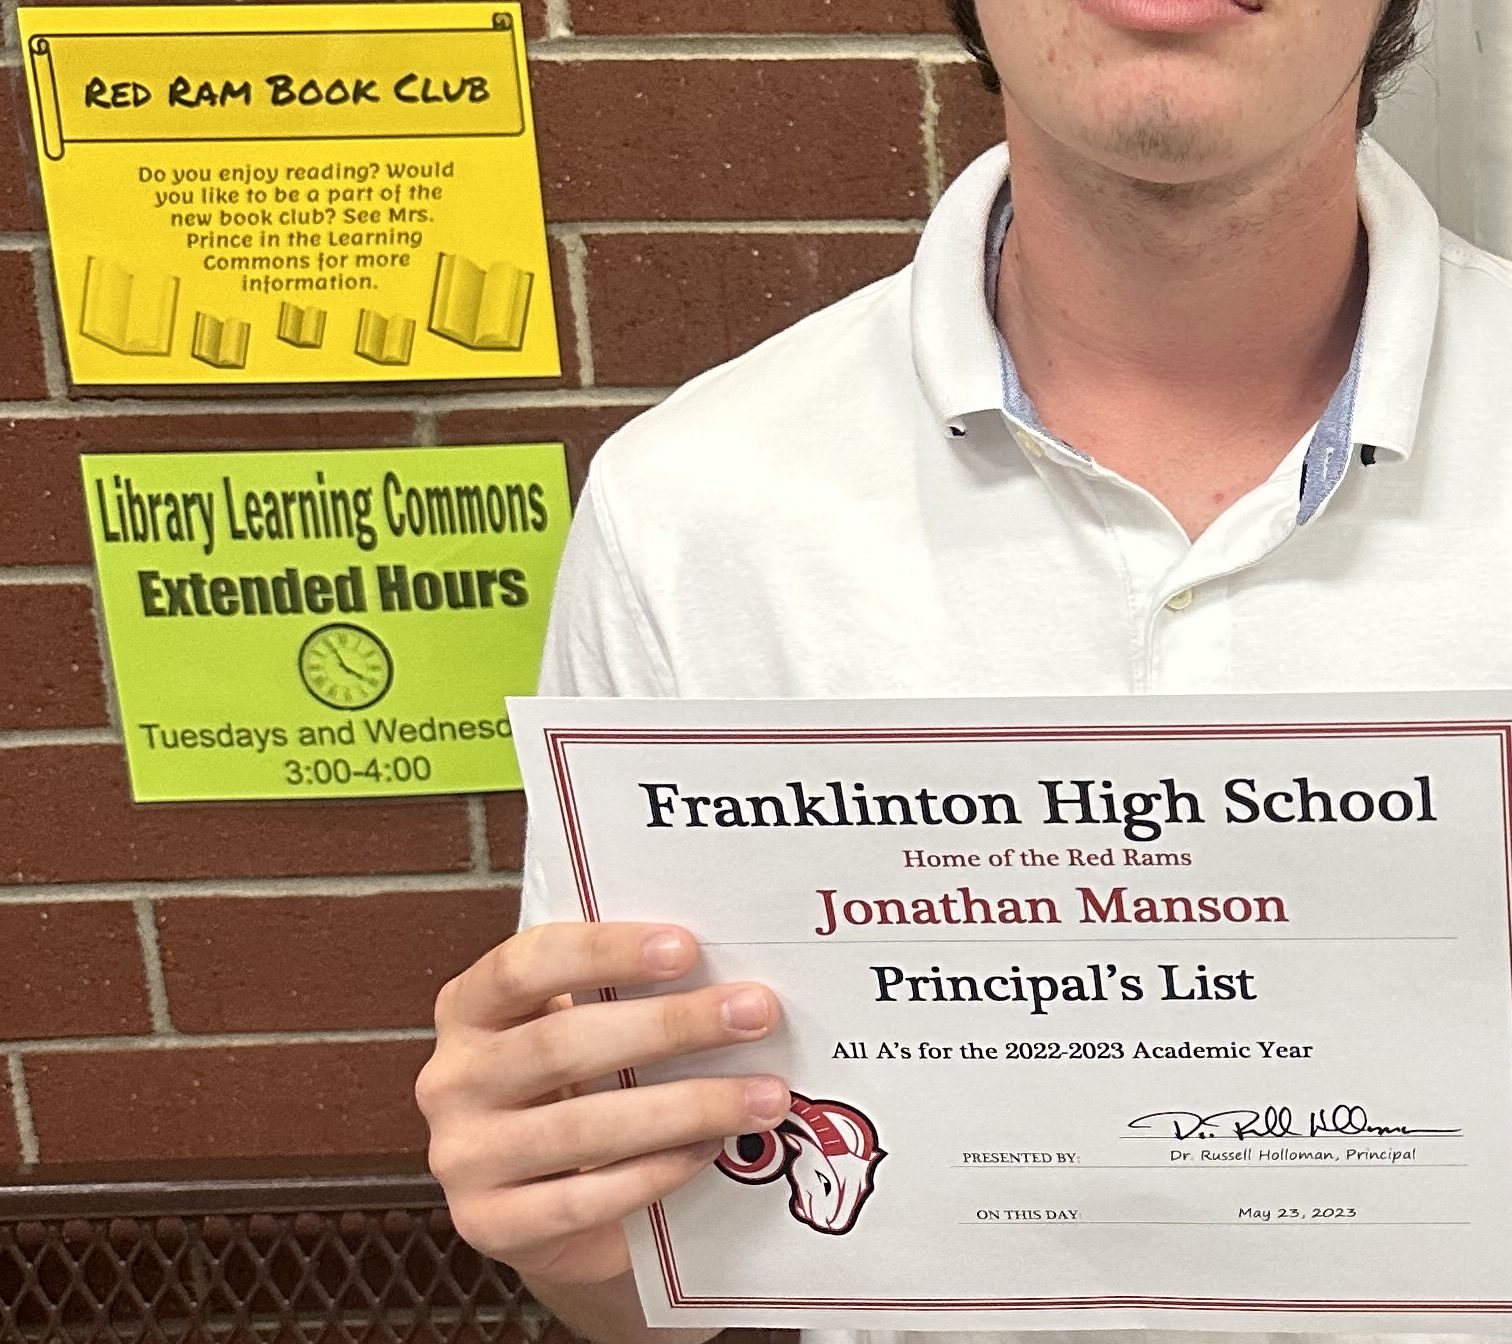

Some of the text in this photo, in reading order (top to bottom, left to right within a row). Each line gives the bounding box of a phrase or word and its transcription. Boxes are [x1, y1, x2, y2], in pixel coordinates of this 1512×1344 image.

[85, 72, 491, 109] RED RAM BOOK CLUB
[138, 161, 455, 186] Do you enjoy reading? Would
[155, 184, 443, 208] you like to be a part of the
[171, 207, 434, 227] new book club? See Mrs.
[187, 230, 423, 249] Prince in the Learning
[203, 252, 410, 271] Commons for more
[242, 274, 378, 294] information.
[96, 471, 548, 556] Library Learning Commons
[137, 565, 530, 617] Extended Hours
[139, 722, 288, 753] Tuesdays
[299, 720, 355, 746] and
[285, 756, 432, 784] 3:00-4:00
[638, 776, 1438, 842] Franklinton High School
[902, 848, 1192, 867] Home of the Red Rams
[815, 886, 1289, 936] Jonathan Manson
[870, 964, 1258, 1015] Principal's List
[832, 1041, 1314, 1060] All A's for the 2022-2023 Academic Year
[962, 1152, 1052, 1164] PRESENTED
[1200, 1148, 1251, 1161] Russell
[1258, 1148, 1340, 1162] Holloman,
[1346, 1148, 1416, 1164] Principal
[976, 1209, 1000, 1220] ON
[1003, 1209, 1042, 1220] THIS
[1238, 1207, 1357, 1222] May 23, 2023
